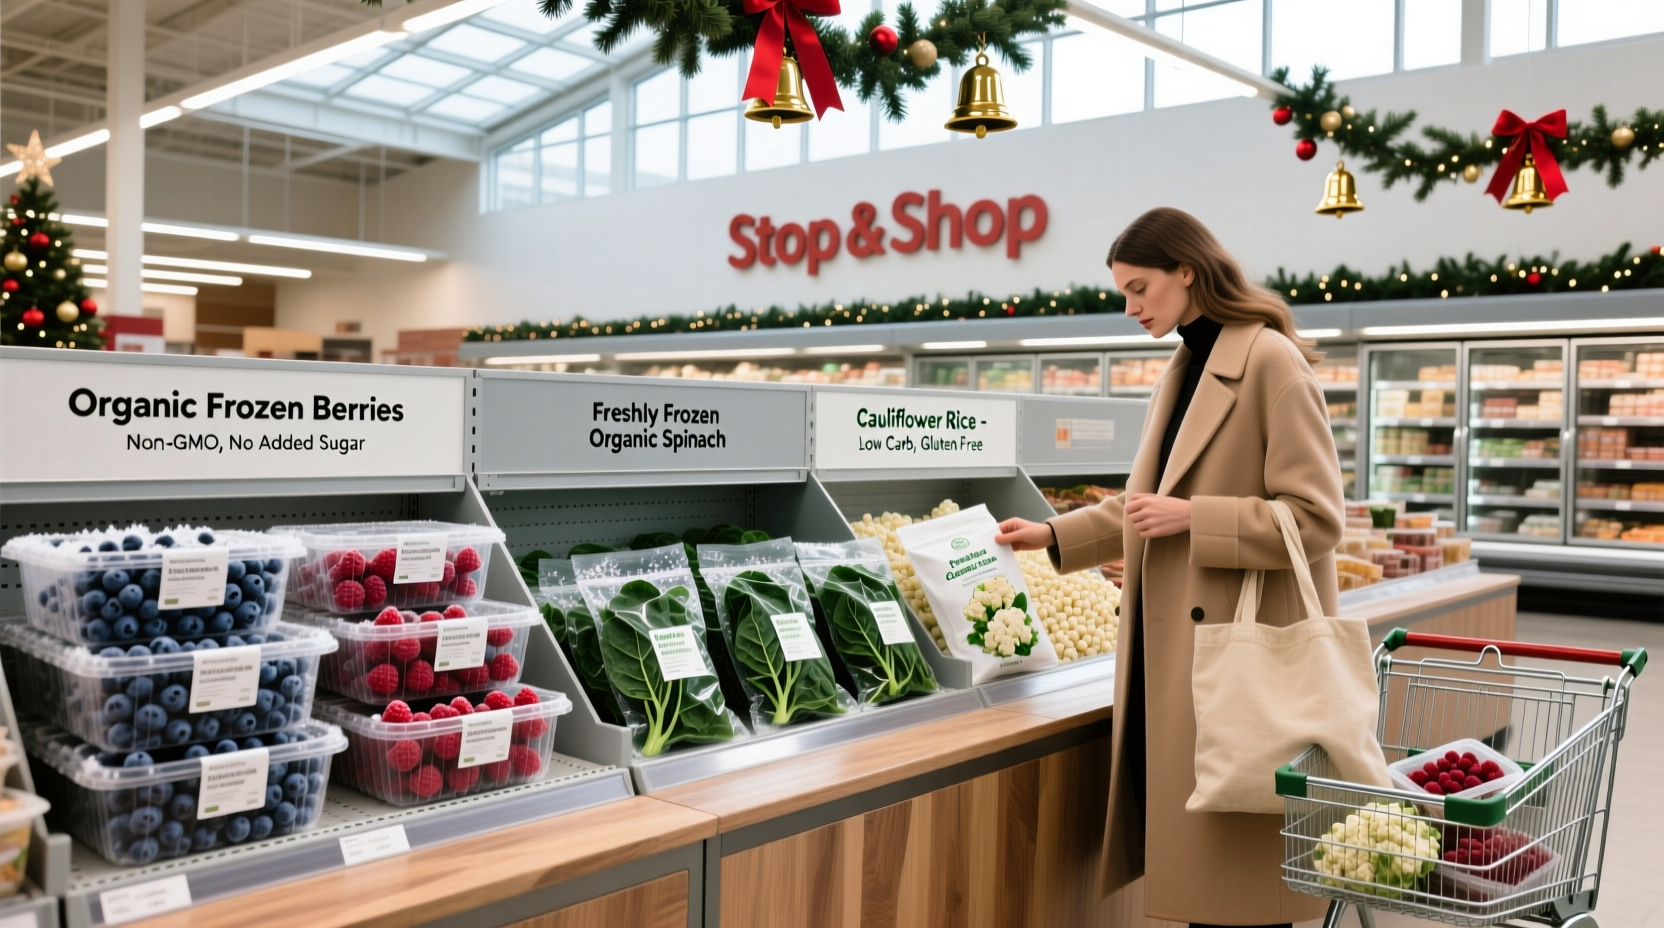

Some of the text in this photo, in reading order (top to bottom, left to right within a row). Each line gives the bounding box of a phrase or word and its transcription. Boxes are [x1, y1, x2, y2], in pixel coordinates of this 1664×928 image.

[728, 189, 1049, 276] Stop & Shop
[68, 387, 404, 426] Organic Frozen Berries
[592, 402, 720, 428] Freshly Frozen
[856, 407, 943, 429] Cauliflower
[946, 409, 977, 430] Rice
[126, 433, 366, 456] Non-GMO, No Added Sugar
[589, 426, 726, 454] Organic Spinach
[858, 434, 984, 454] Low Carb, Gluten Free
